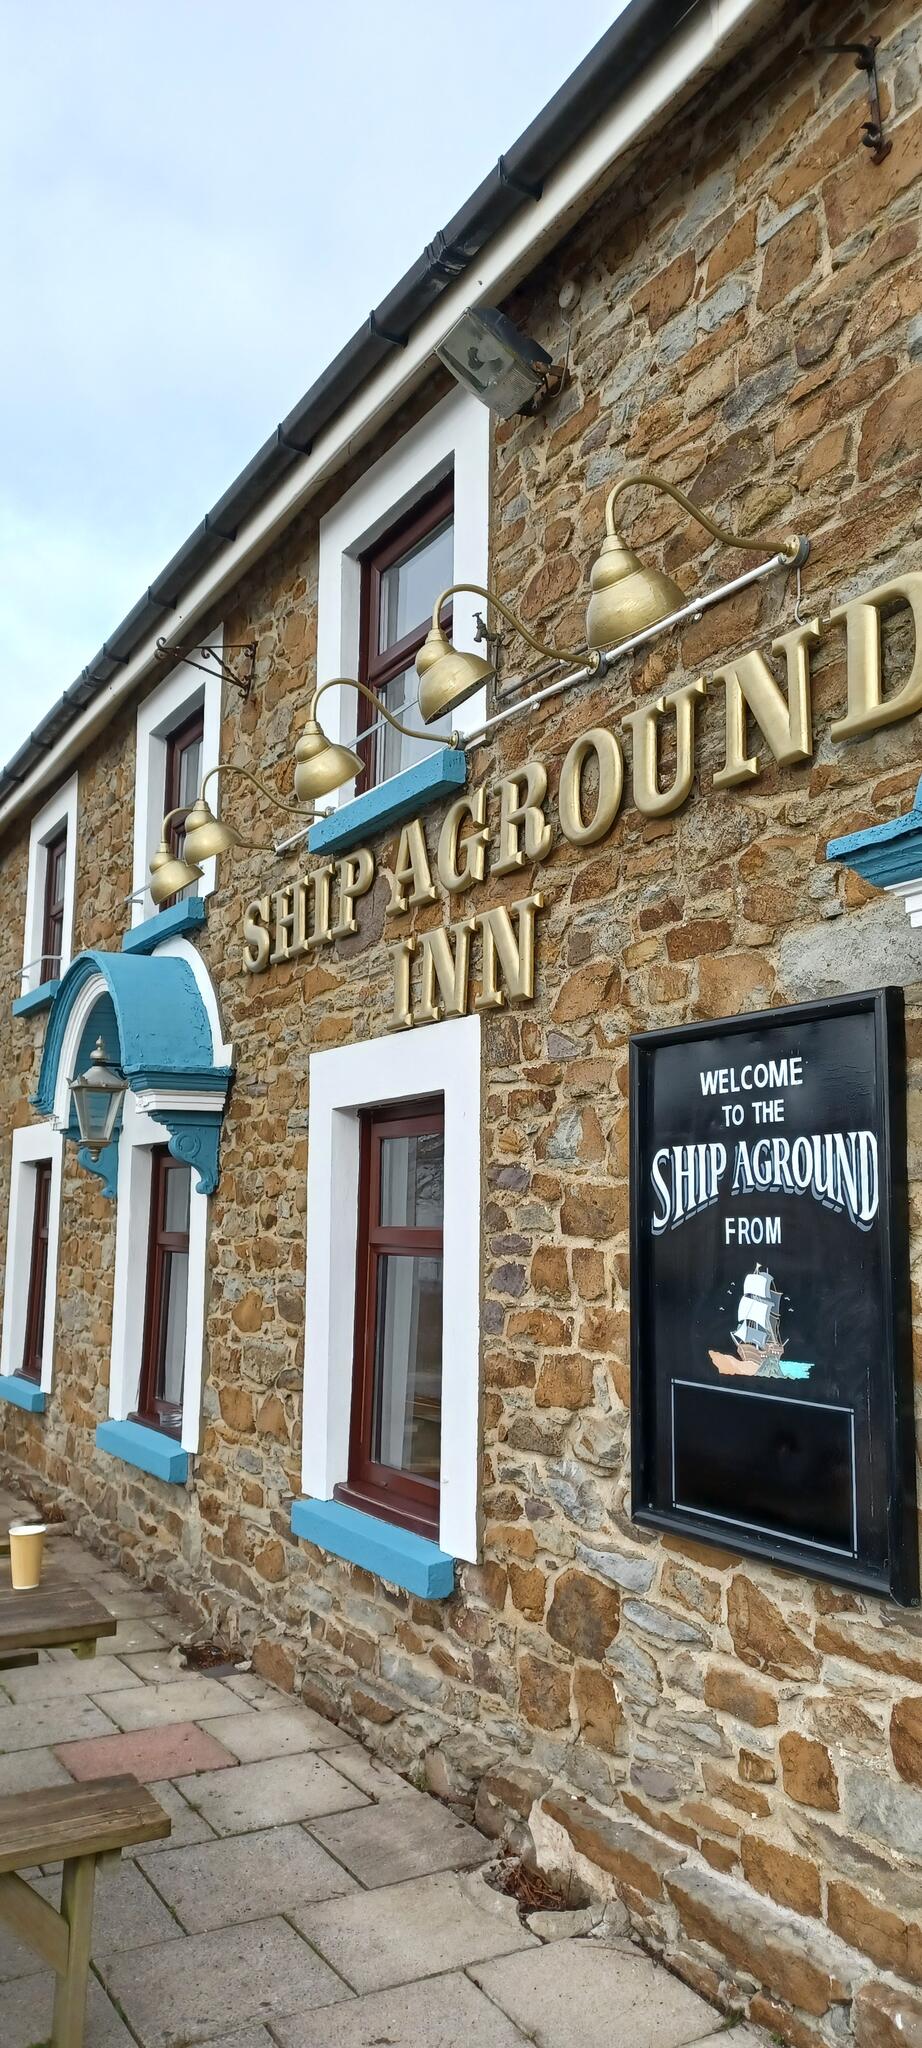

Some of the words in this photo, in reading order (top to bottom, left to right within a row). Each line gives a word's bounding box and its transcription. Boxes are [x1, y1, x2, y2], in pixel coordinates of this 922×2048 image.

[241, 847, 375, 974] SHIP
[385, 571, 922, 917] AGROUND
[386, 893, 544, 1032] INN
[699, 1056, 804, 1096] WELCOME
[721, 1104, 745, 1127] TO
[751, 1098, 785, 1124] THE
[651, 1142, 727, 1235] SHIP
[730, 1130, 879, 1231] AGROUND
[724, 1216, 783, 1246] FROM
